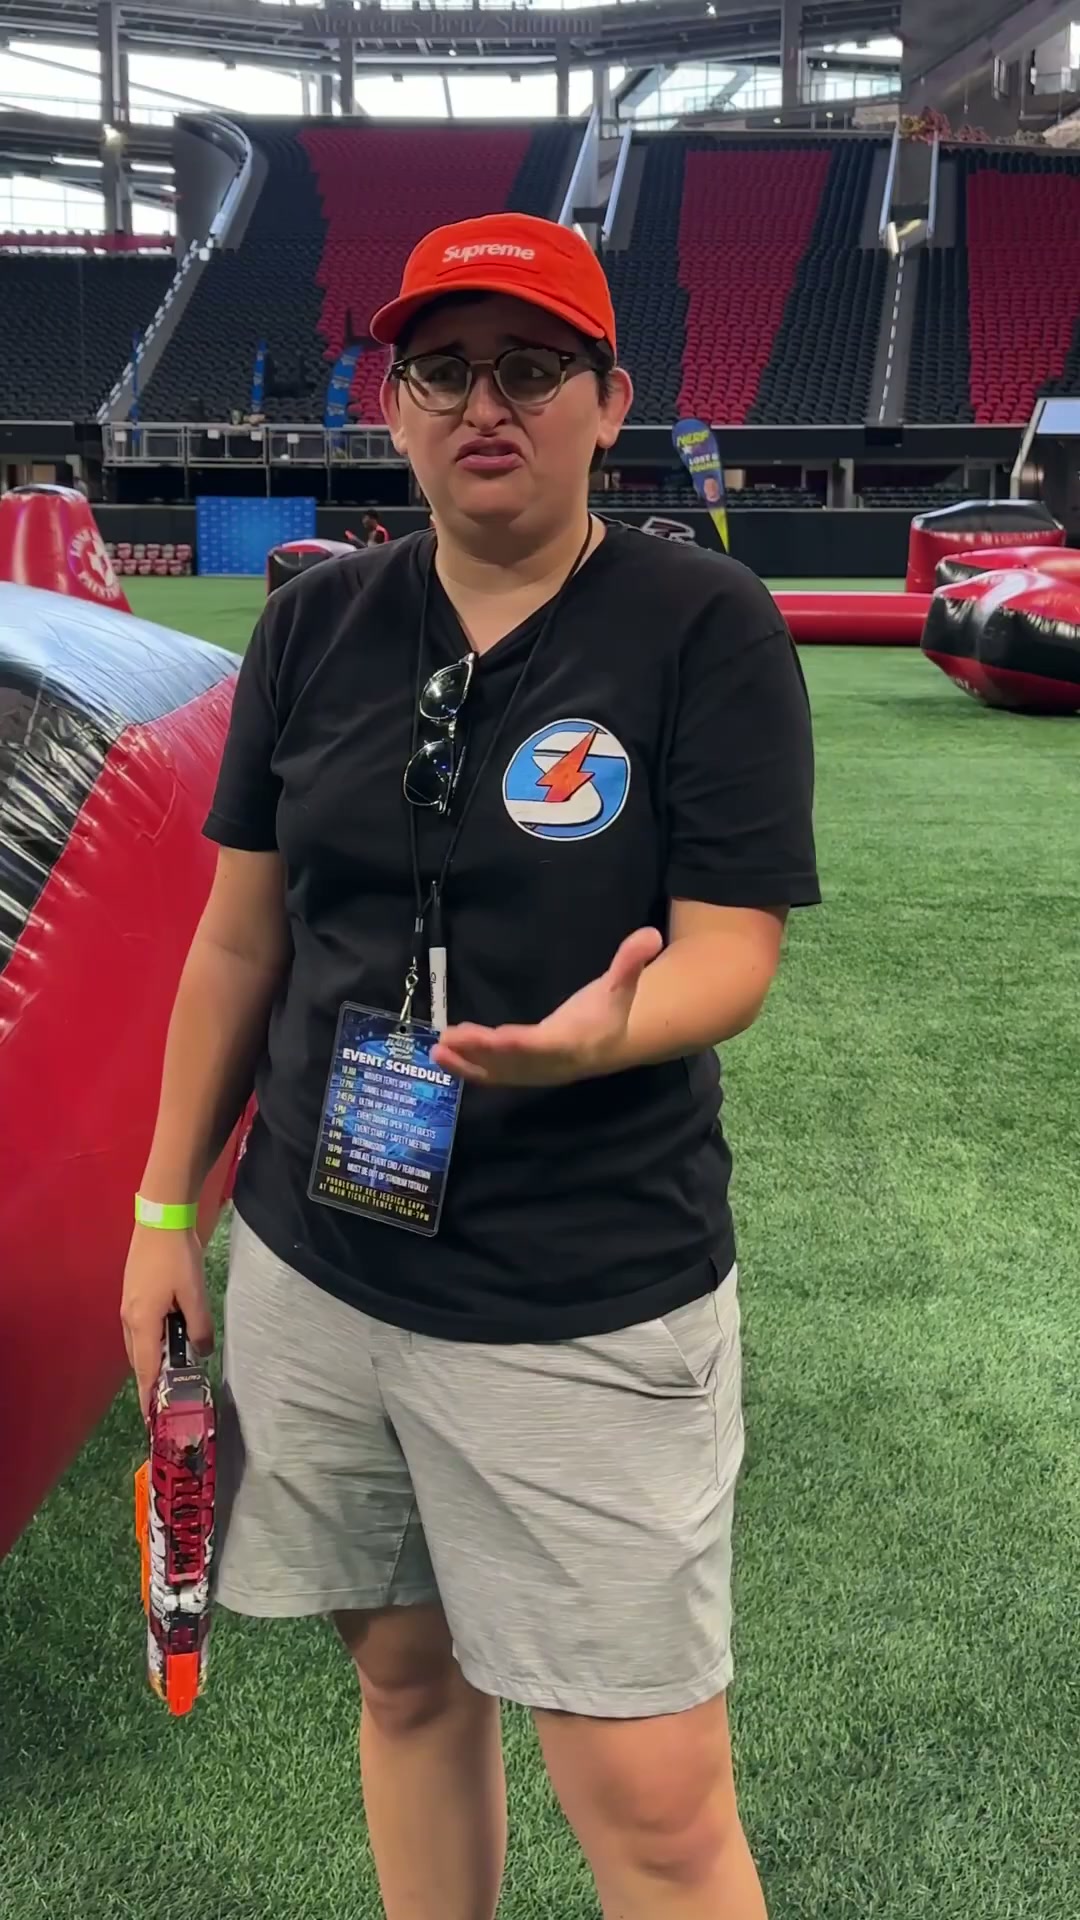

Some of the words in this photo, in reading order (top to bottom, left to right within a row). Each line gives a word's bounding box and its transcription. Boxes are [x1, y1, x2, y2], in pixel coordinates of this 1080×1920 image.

[431, 12, 486, 34] Benz
[441, 243, 535, 263] Supreme
[342, 1048, 386, 1068] EVENT
[385, 1059, 452, 1086] SCHEDULE
[333, 1145, 343, 1154] PM
[319, 1182, 327, 1191] AT
[329, 1185, 346, 1196] MAIN
[347, 1190, 370, 1204] TICKET
[379, 1191, 406, 1206] JESSICA
